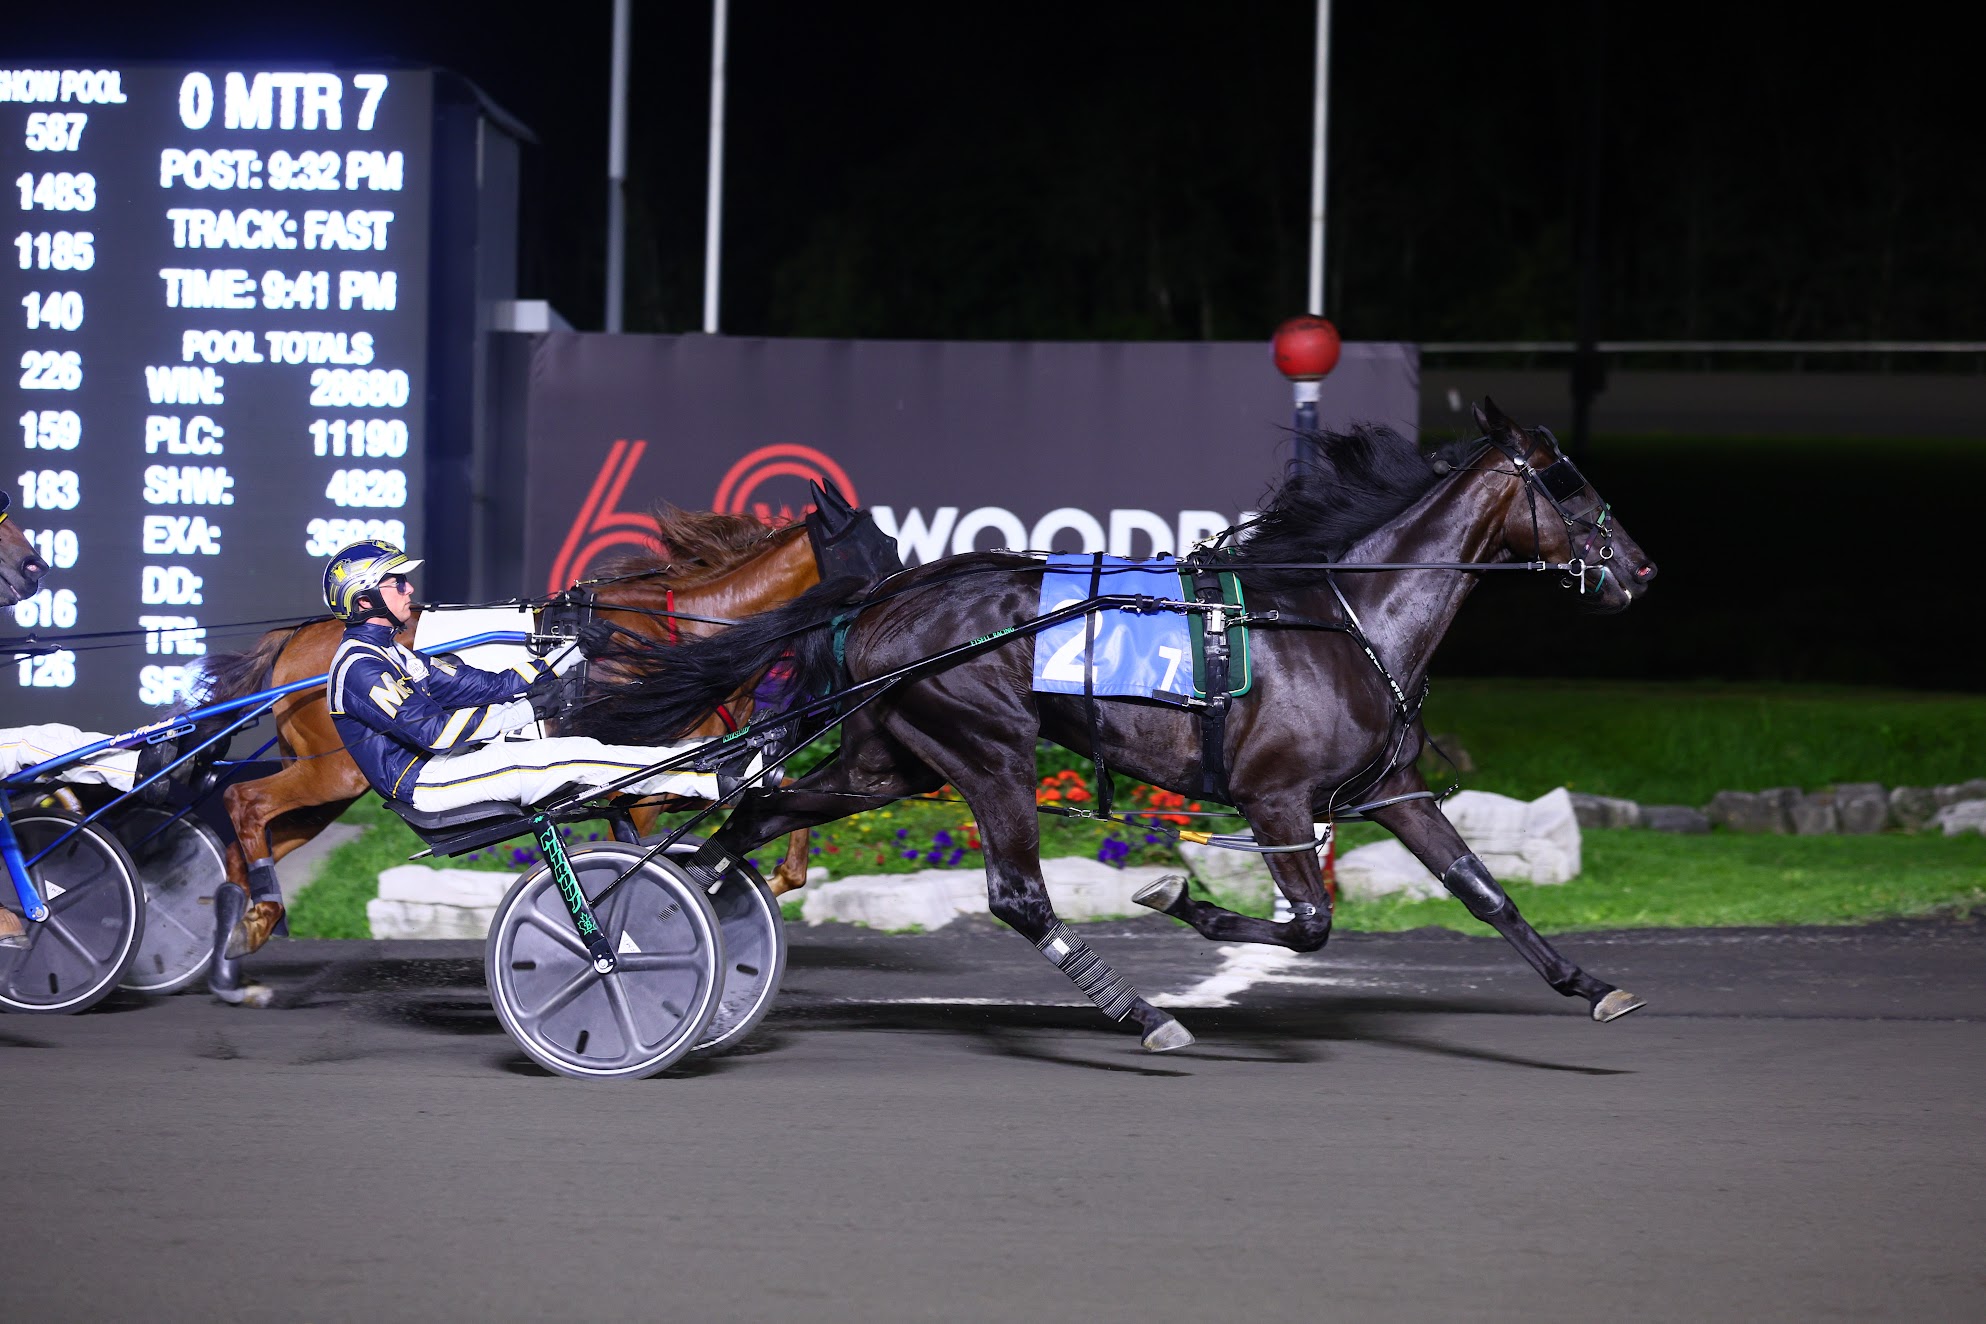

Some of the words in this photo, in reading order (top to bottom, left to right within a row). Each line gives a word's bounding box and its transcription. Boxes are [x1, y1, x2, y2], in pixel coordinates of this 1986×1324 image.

[0, 70, 60, 102] HOW
[60, 70, 127, 103] POOL
[179, 72, 213, 129] 0
[225, 72, 342, 130] MTR
[354, 74, 387, 130] 7
[26, 113, 87, 151] 587
[160, 149, 263, 190] POST:
[268, 150, 340, 190] 9:32
[345, 151, 403, 190] PM
[16, 172, 96, 211] 1483
[167, 209, 297, 249] TRACK:
[304, 210, 394, 250] FAST
[14, 231, 95, 270] 1185
[159, 268, 256, 308] TIME:
[261, 270, 329, 309] 9:41
[339, 270, 397, 310] PM
[22, 291, 83, 331] 140
[182, 330, 263, 363] POOL
[265, 331, 374, 365] TOTALS
[20, 351, 82, 390] 226
[145, 366, 224, 404] WIN:
[310, 368, 409, 407] 28680
[20, 410, 81, 450] 159
[145, 415, 223, 455] PLC:
[309, 419, 408, 457] 11190
[18, 470, 80, 510] 183
[143, 465, 234, 505] SHW:
[325, 469, 406, 507] 4828
[143, 515, 221, 554] EXA:
[142, 566, 203, 604] DD:
[1042, 598, 1103, 683] 2
[14, 650, 76, 688] 126
[1158, 645, 1182, 692] 7
